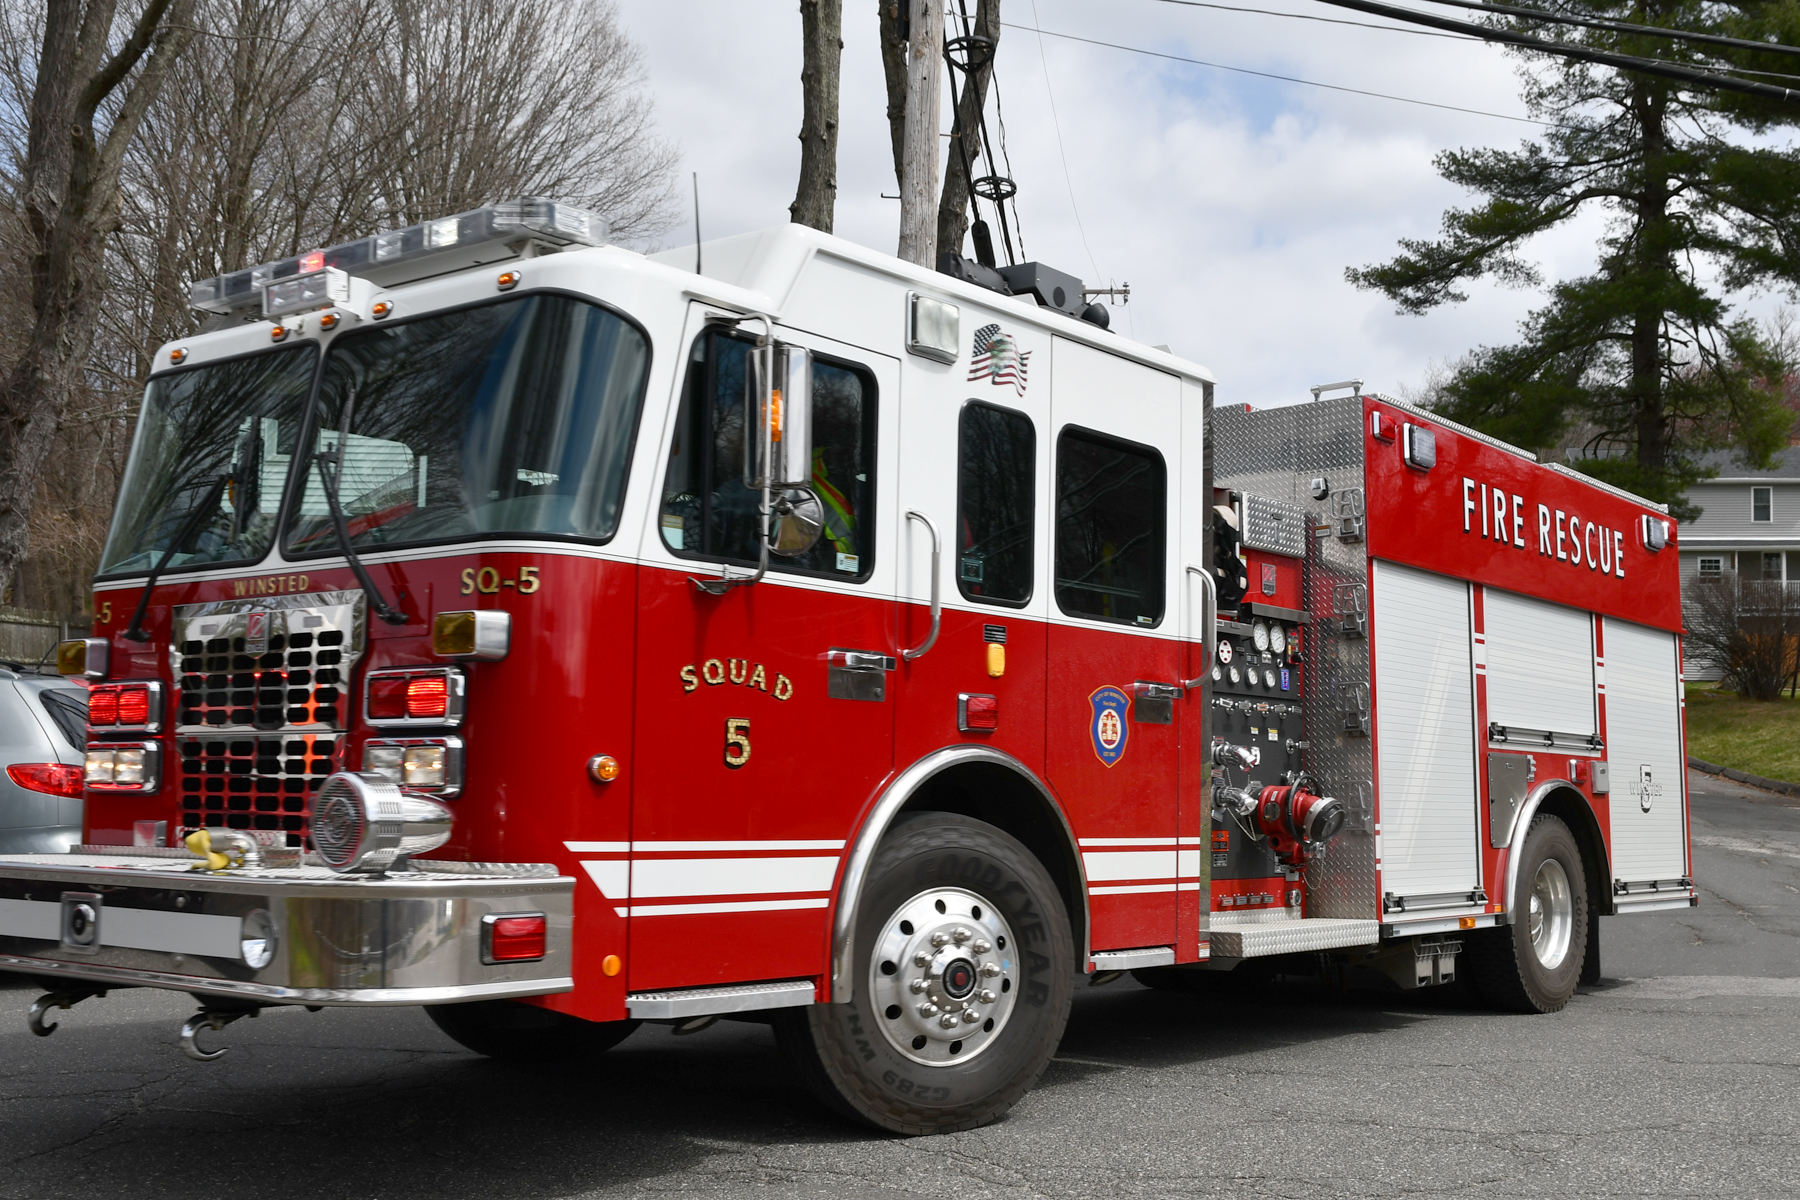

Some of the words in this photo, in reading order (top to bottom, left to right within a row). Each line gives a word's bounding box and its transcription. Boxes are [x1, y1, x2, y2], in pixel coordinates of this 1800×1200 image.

[1462, 476, 1525, 549] FIRE
[1538, 503, 1625, 579] RESCUE
[233, 574, 310, 597] WINSTED
[460, 566, 540, 595] SQ-5
[94, 601, 112, 625] -5
[680, 658, 793, 701] SQUAD
[724, 717, 751, 769] 5
[1640, 764, 1653, 813] 5
[916, 854, 1049, 1007] GOODYEAR
[882, 1070, 950, 1101] G289
